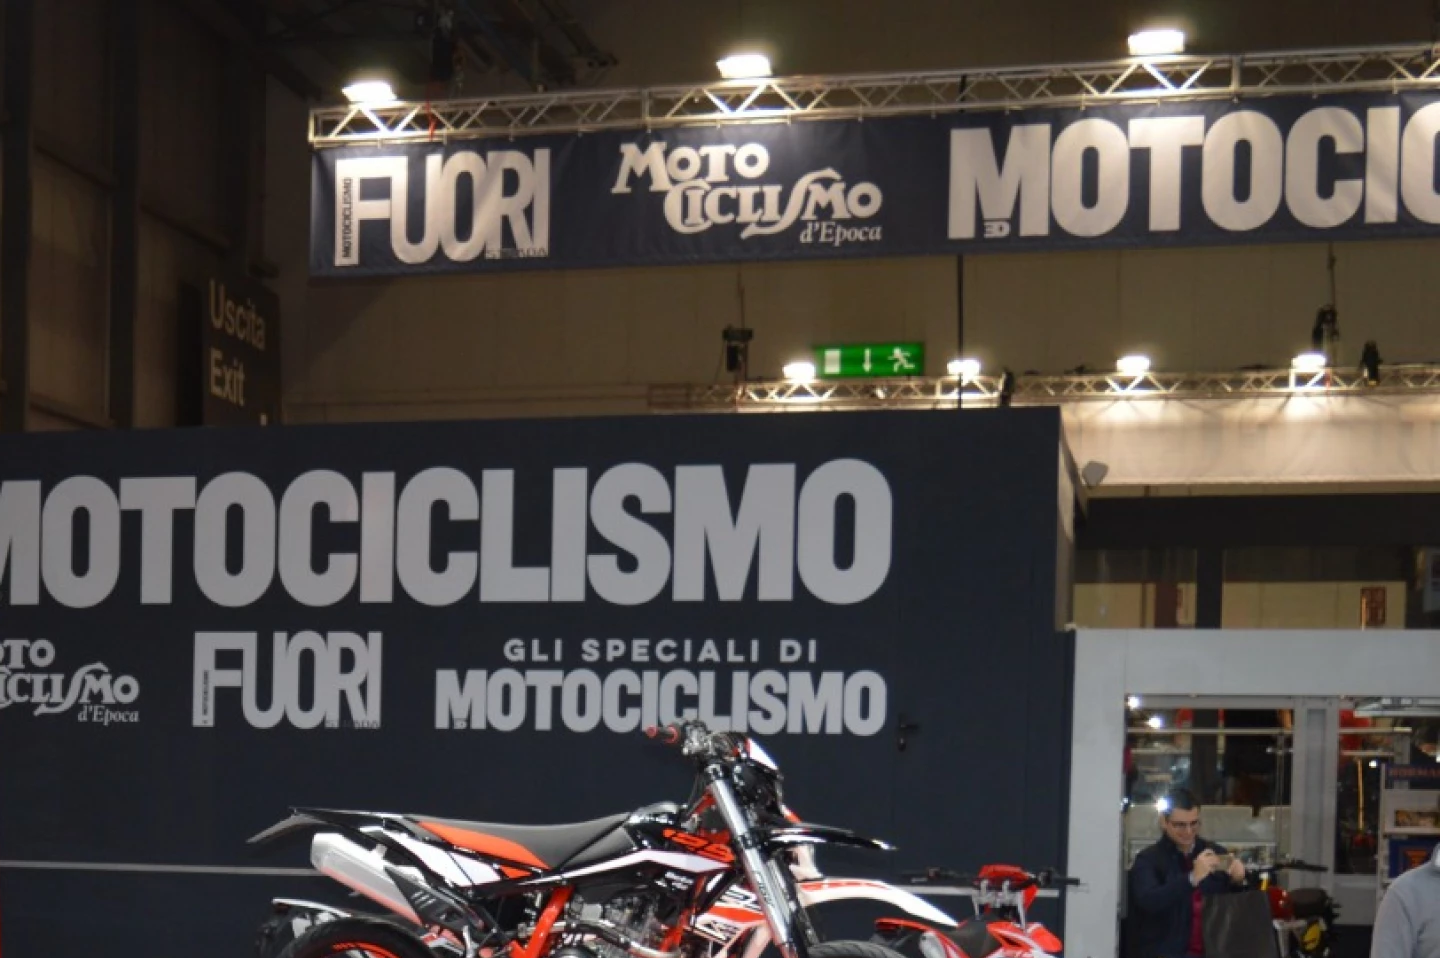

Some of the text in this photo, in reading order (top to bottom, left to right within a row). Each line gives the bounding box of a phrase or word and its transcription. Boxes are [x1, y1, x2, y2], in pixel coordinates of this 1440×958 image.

[334, 148, 550, 267] FUORI
[341, 177, 353, 259] MOTOCICLISMO
[209, 278, 266, 351] Uscita
[209, 347, 245, 407] Exit
[192, 630, 383, 729] FUORI
[503, 638, 817, 662] GLI SPECIALI DI
[435, 668, 888, 737] MOTOCICLISMO
